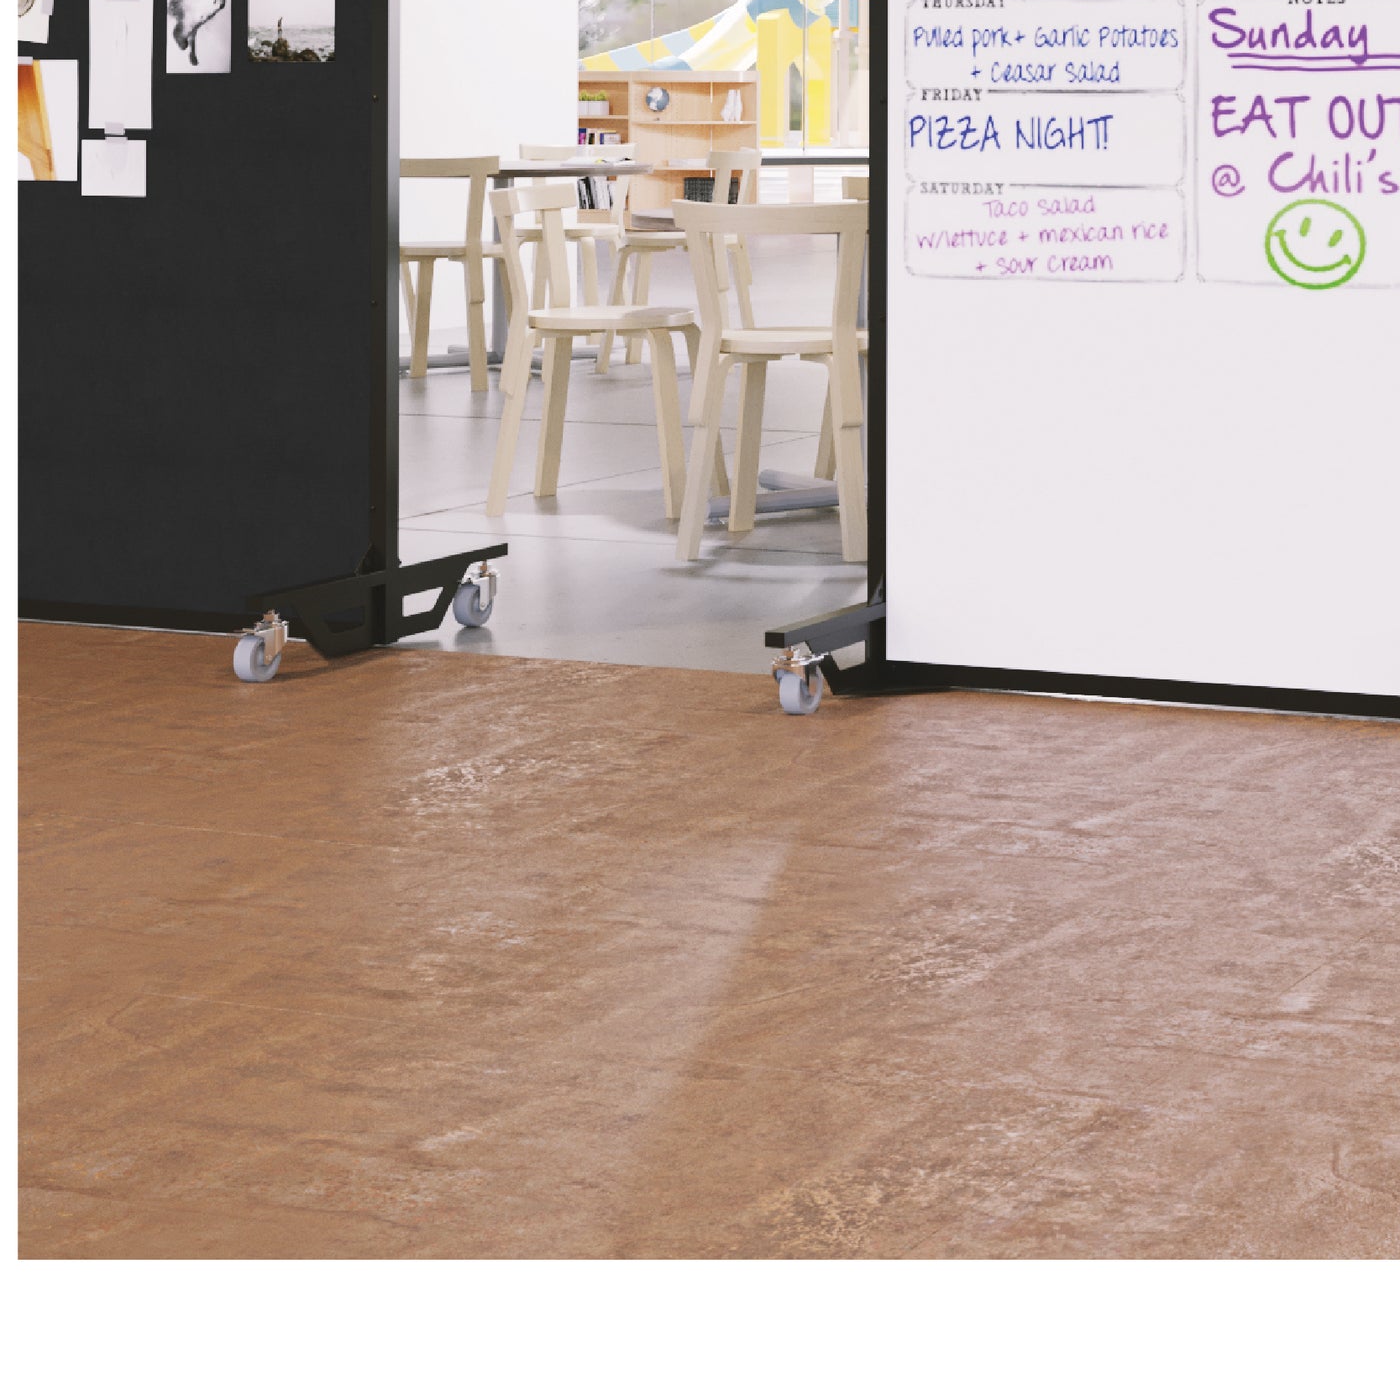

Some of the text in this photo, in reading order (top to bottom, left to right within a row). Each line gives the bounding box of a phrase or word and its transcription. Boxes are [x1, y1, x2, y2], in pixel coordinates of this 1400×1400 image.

[1209, 7, 1368, 65] Sunday
[921, 88, 983, 102] FRIDAY
[1211, 96, 1311, 138] EAT
[909, 115, 1113, 151] PIZZA NIGHT!
[1211, 148, 1399, 197] @ Chili's
[919, 182, 1004, 195] SATURDAY
[983, 199, 1028, 218] Taco
[1039, 224, 1123, 243] mexican
[1132, 222, 1168, 240] rice
